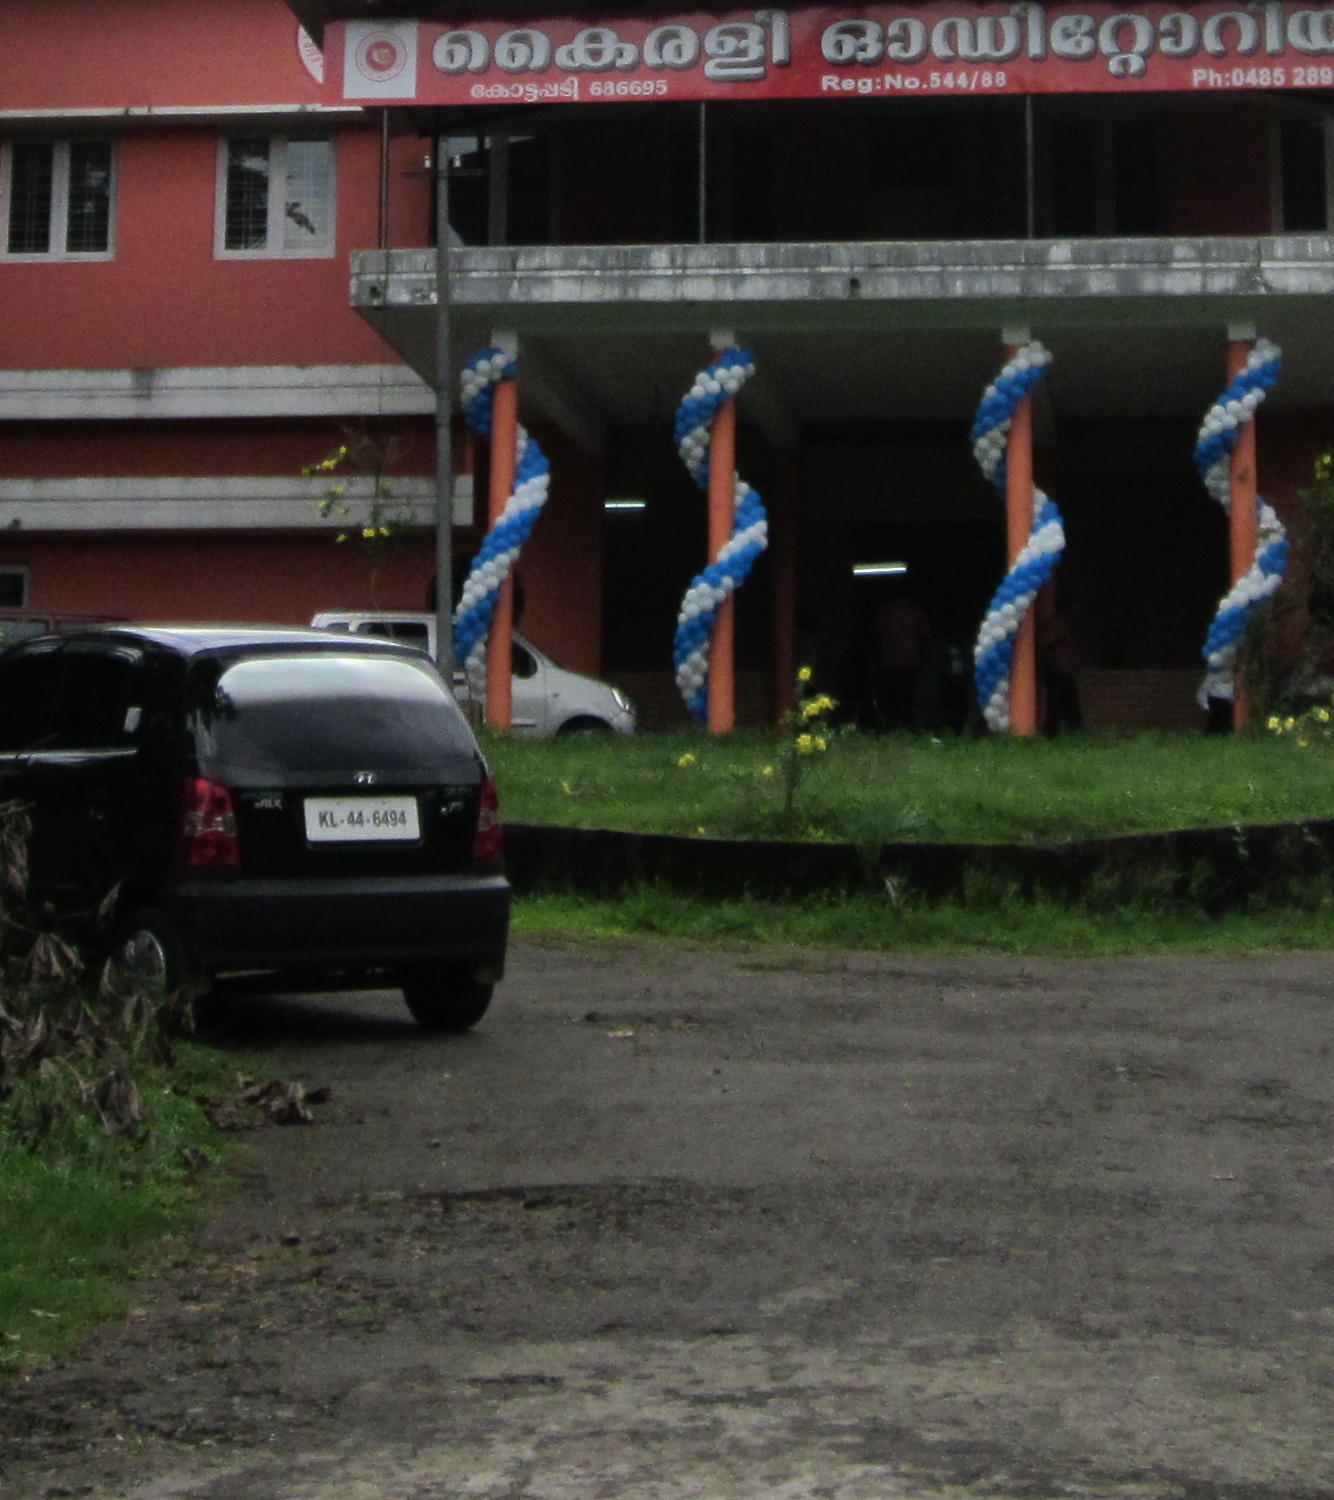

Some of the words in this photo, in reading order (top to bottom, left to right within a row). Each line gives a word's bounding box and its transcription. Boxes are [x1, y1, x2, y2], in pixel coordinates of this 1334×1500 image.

[431, 8, 792, 83] കൈരളി
[589, 79, 668, 97] 686695
[1191, 67, 1286, 88] Ph:0485
